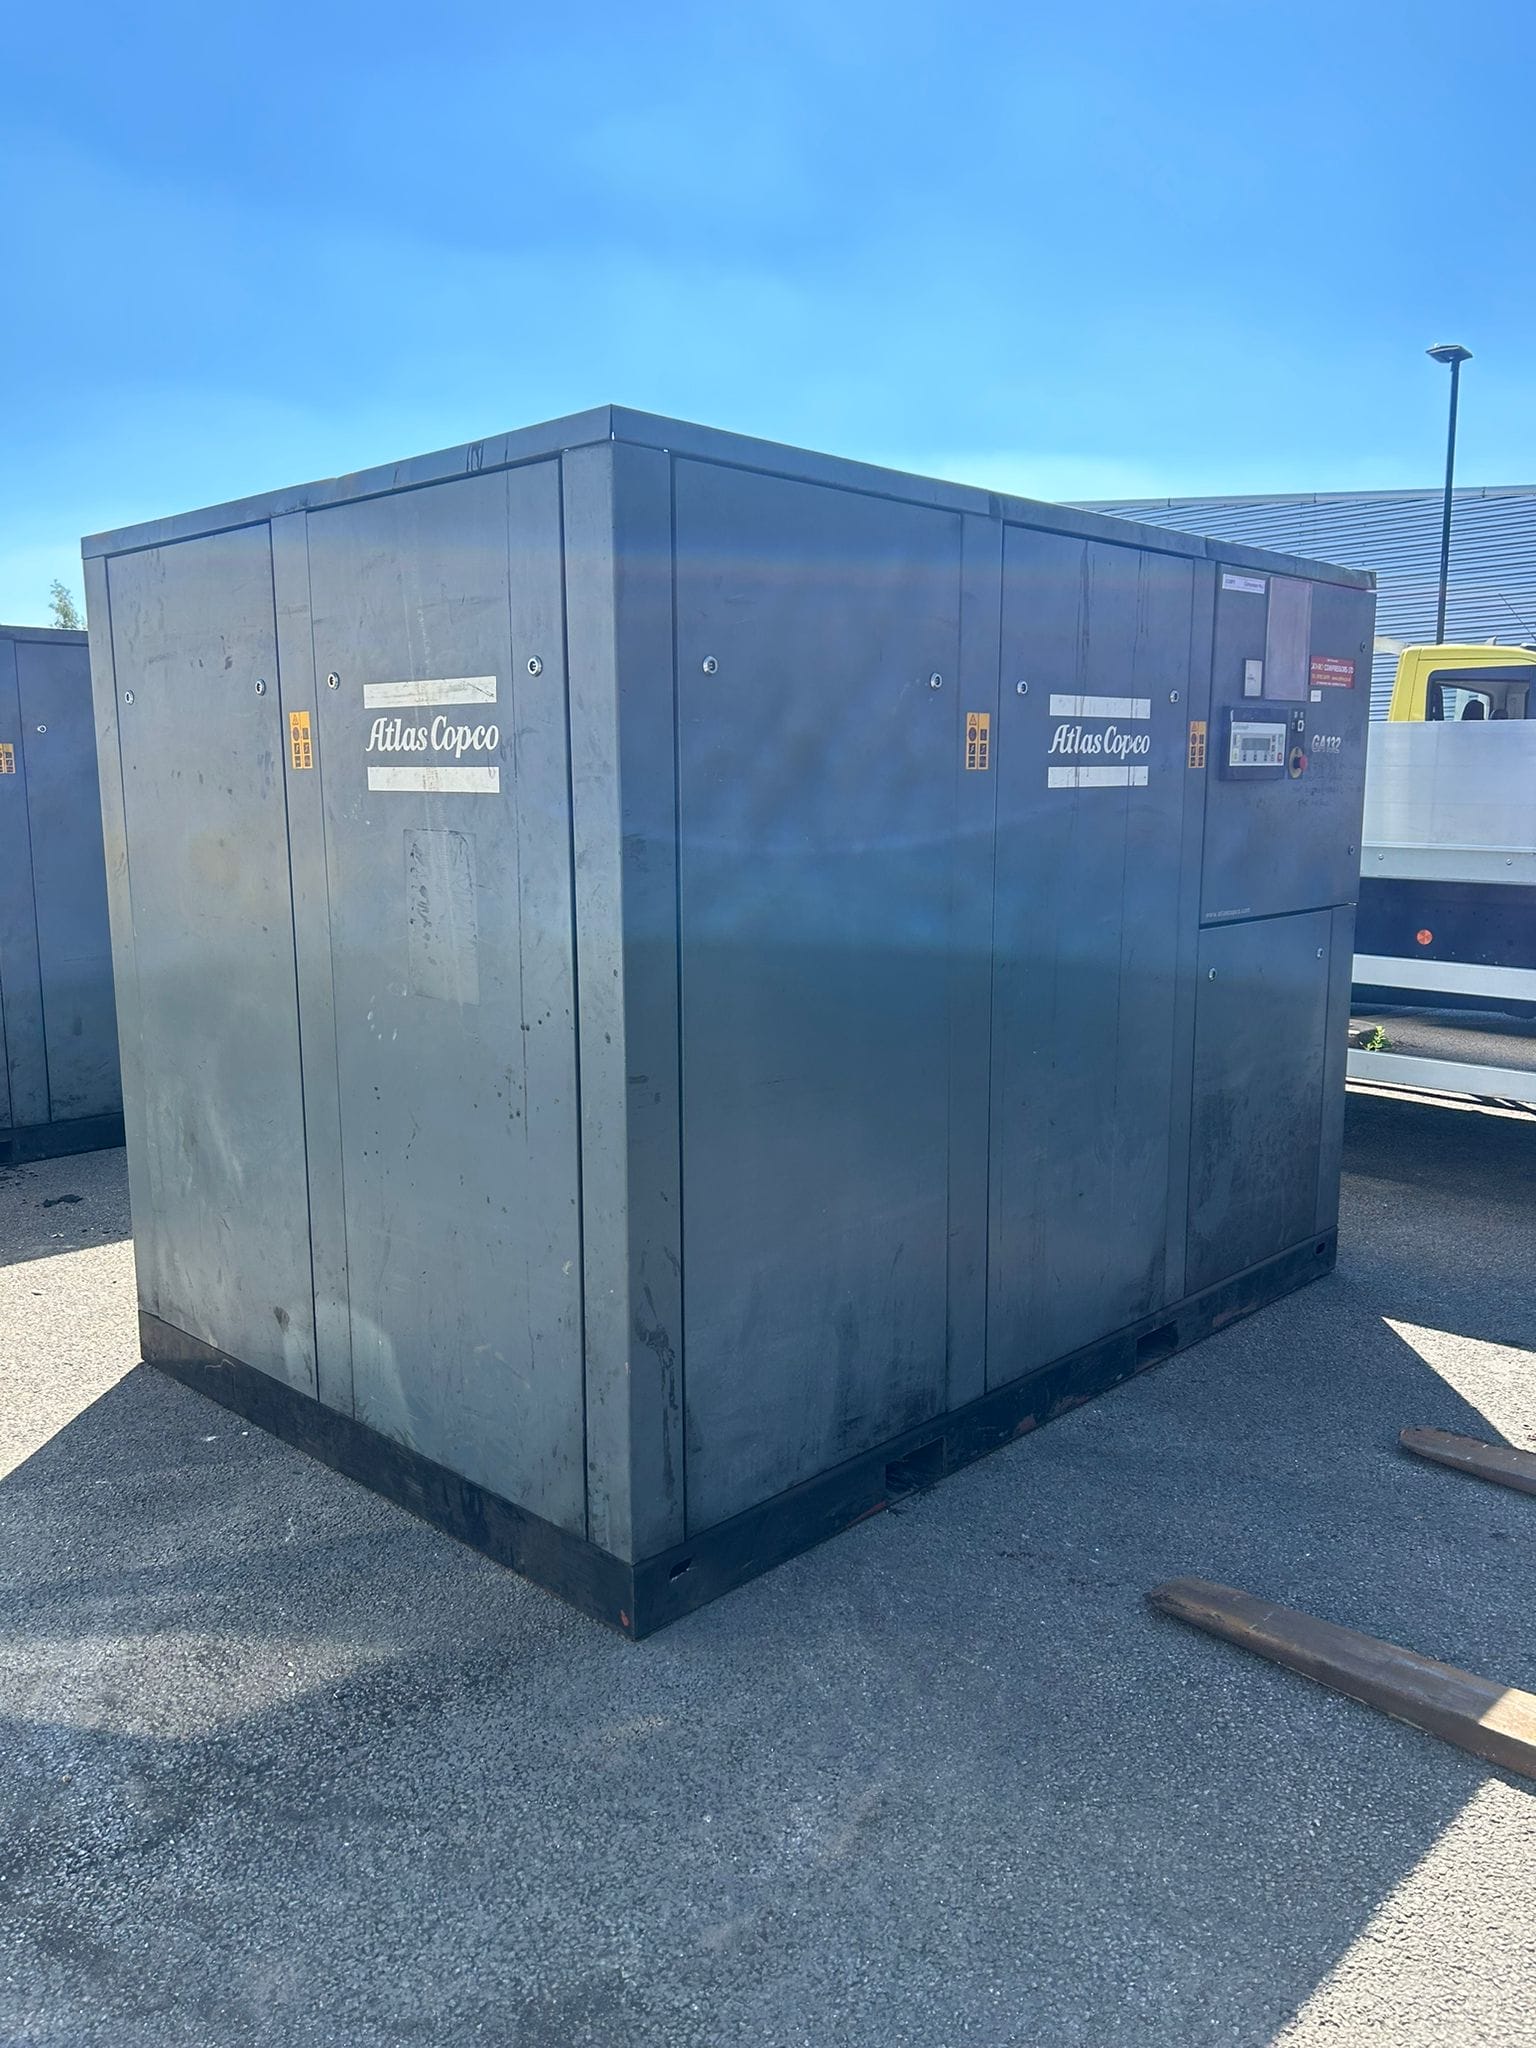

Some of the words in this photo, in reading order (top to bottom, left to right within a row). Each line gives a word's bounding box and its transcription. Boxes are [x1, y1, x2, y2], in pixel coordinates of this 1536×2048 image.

[365, 717, 428, 752] Atlas
[430, 715, 499, 758] Copco
[1047, 724, 1102, 754] Atlas
[1103, 725, 1150, 760] Copco
